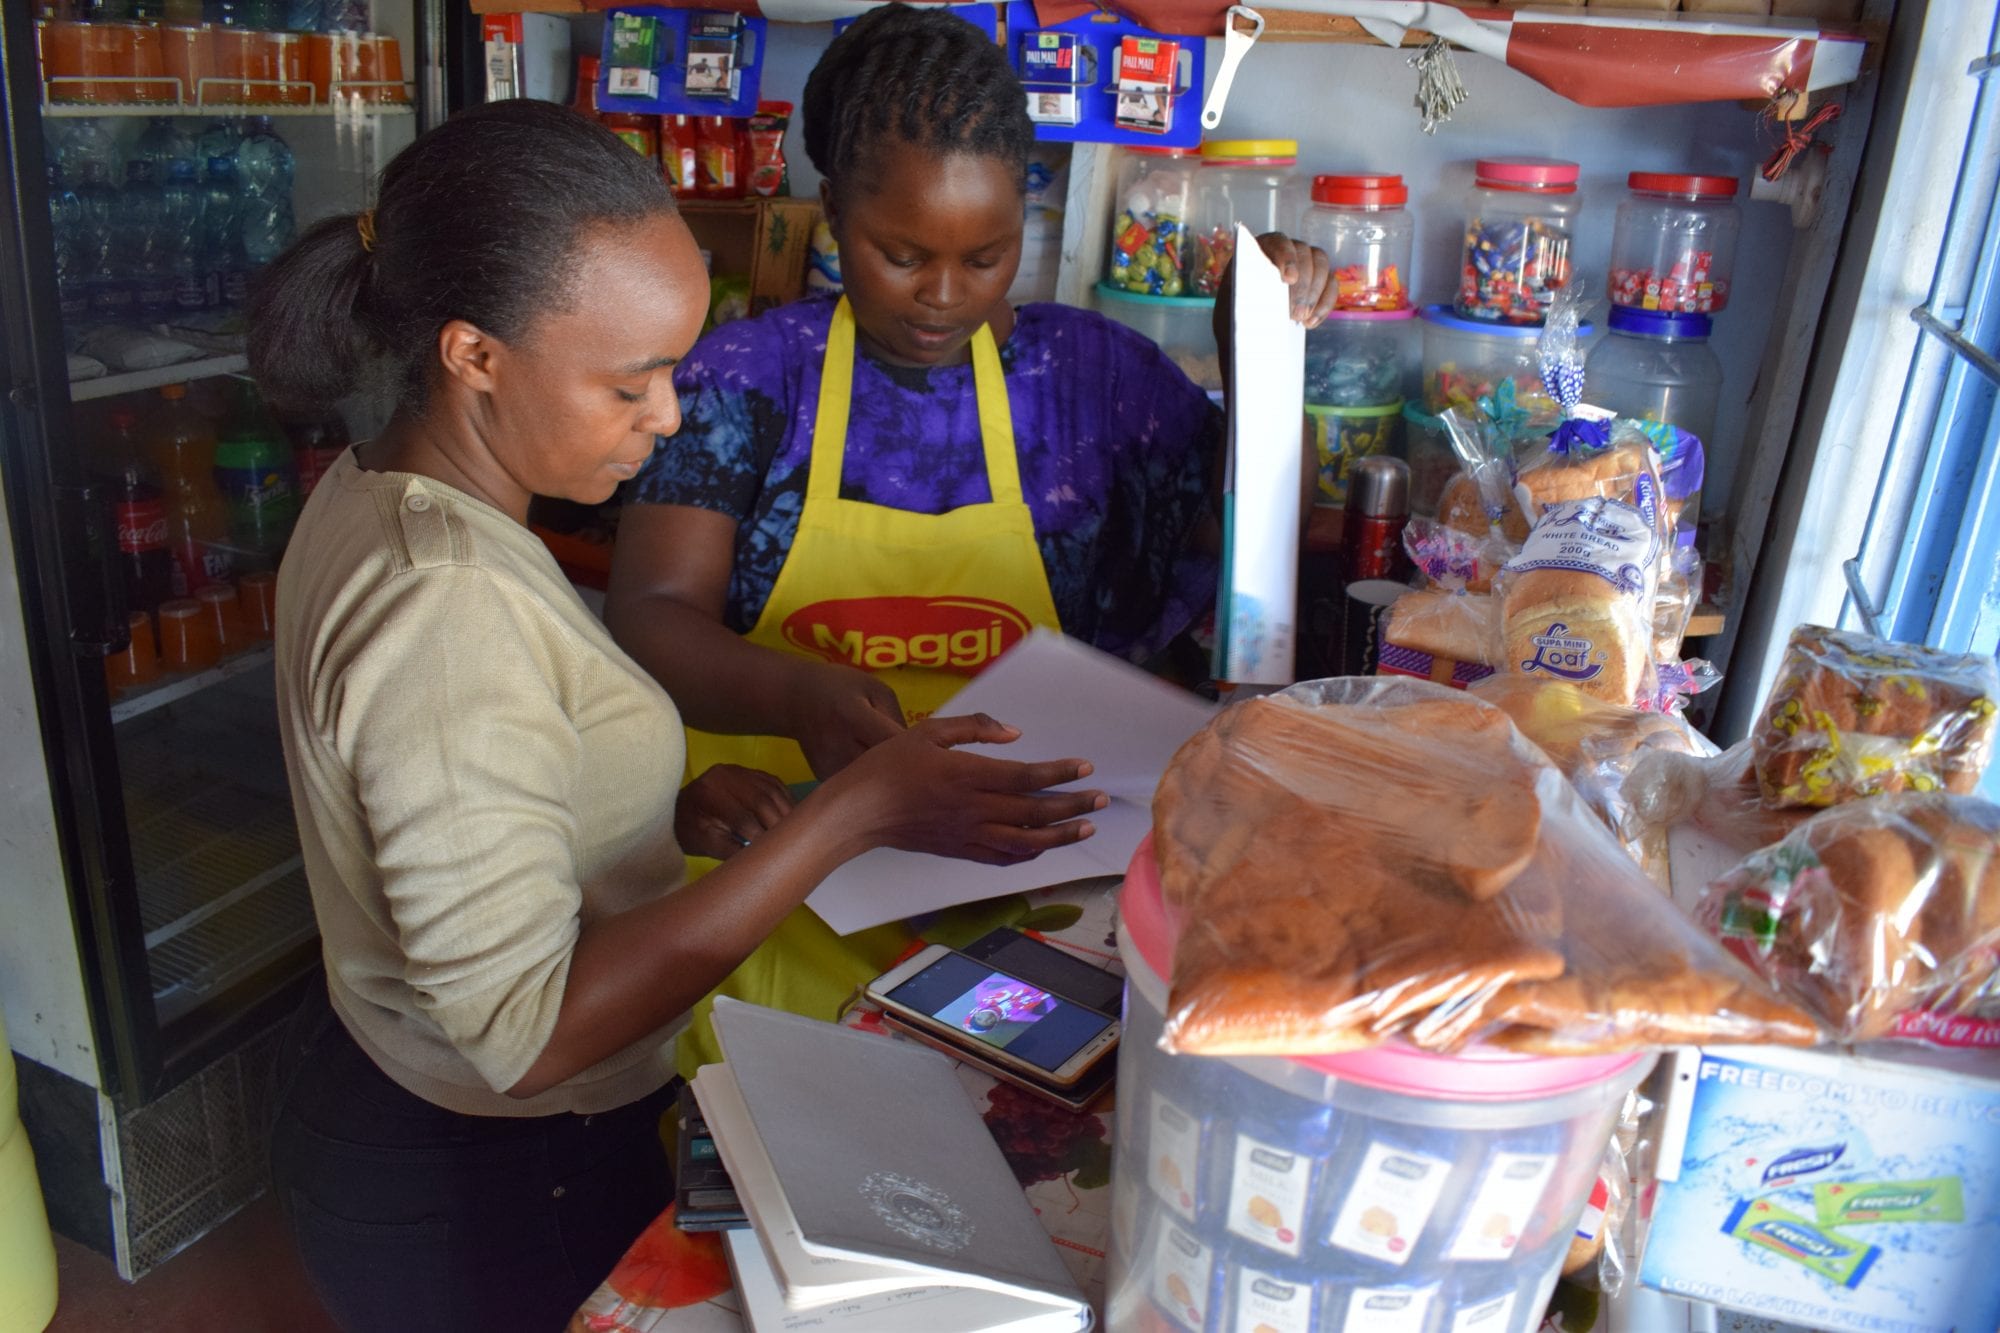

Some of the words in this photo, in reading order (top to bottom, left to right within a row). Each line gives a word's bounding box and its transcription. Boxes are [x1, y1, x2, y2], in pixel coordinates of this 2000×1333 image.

[1026, 51, 1040, 63] PALL
[1041, 51, 1056, 64] MALL
[1123, 55, 1137, 68] PALL
[1138, 57, 1154, 71] MALL
[1542, 531, 1577, 540] WHITE
[1580, 532, 1620, 552] BREAD
[1559, 546, 1592, 558] 200g
[812, 620, 1002, 669] Maggi
[1537, 638, 1562, 647] SUPA
[1564, 640, 1587, 649] MINI
[1700, 1061, 1855, 1103] FREEDOM
[1768, 1151, 1834, 1179] FRESH
[1850, 1192, 1922, 1209] FRESH
[1763, 1221, 1834, 1257] FRESH
